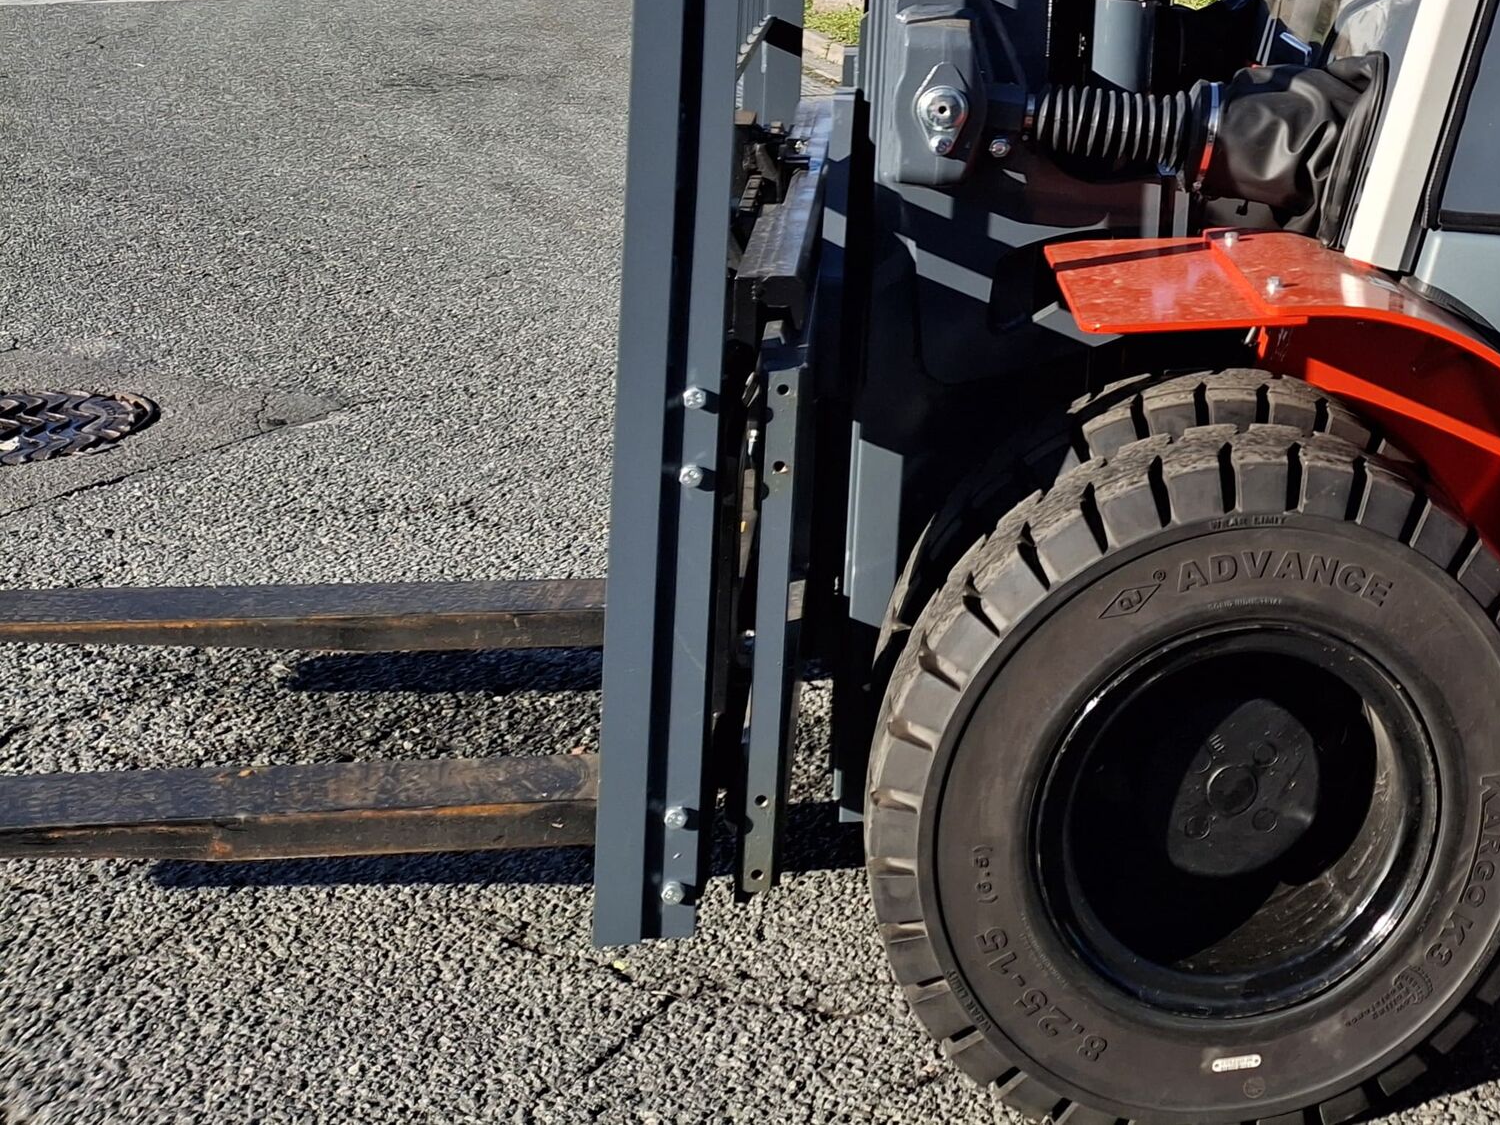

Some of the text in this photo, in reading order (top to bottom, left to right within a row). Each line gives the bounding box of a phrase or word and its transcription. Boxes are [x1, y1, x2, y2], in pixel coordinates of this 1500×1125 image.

[1209, 515, 1288, 530] WEAR LIMIT
[1177, 550, 1394, 607] ADVANCE
[1424, 911, 1473, 968] K3
[974, 927, 1108, 1062] 8.25-15
